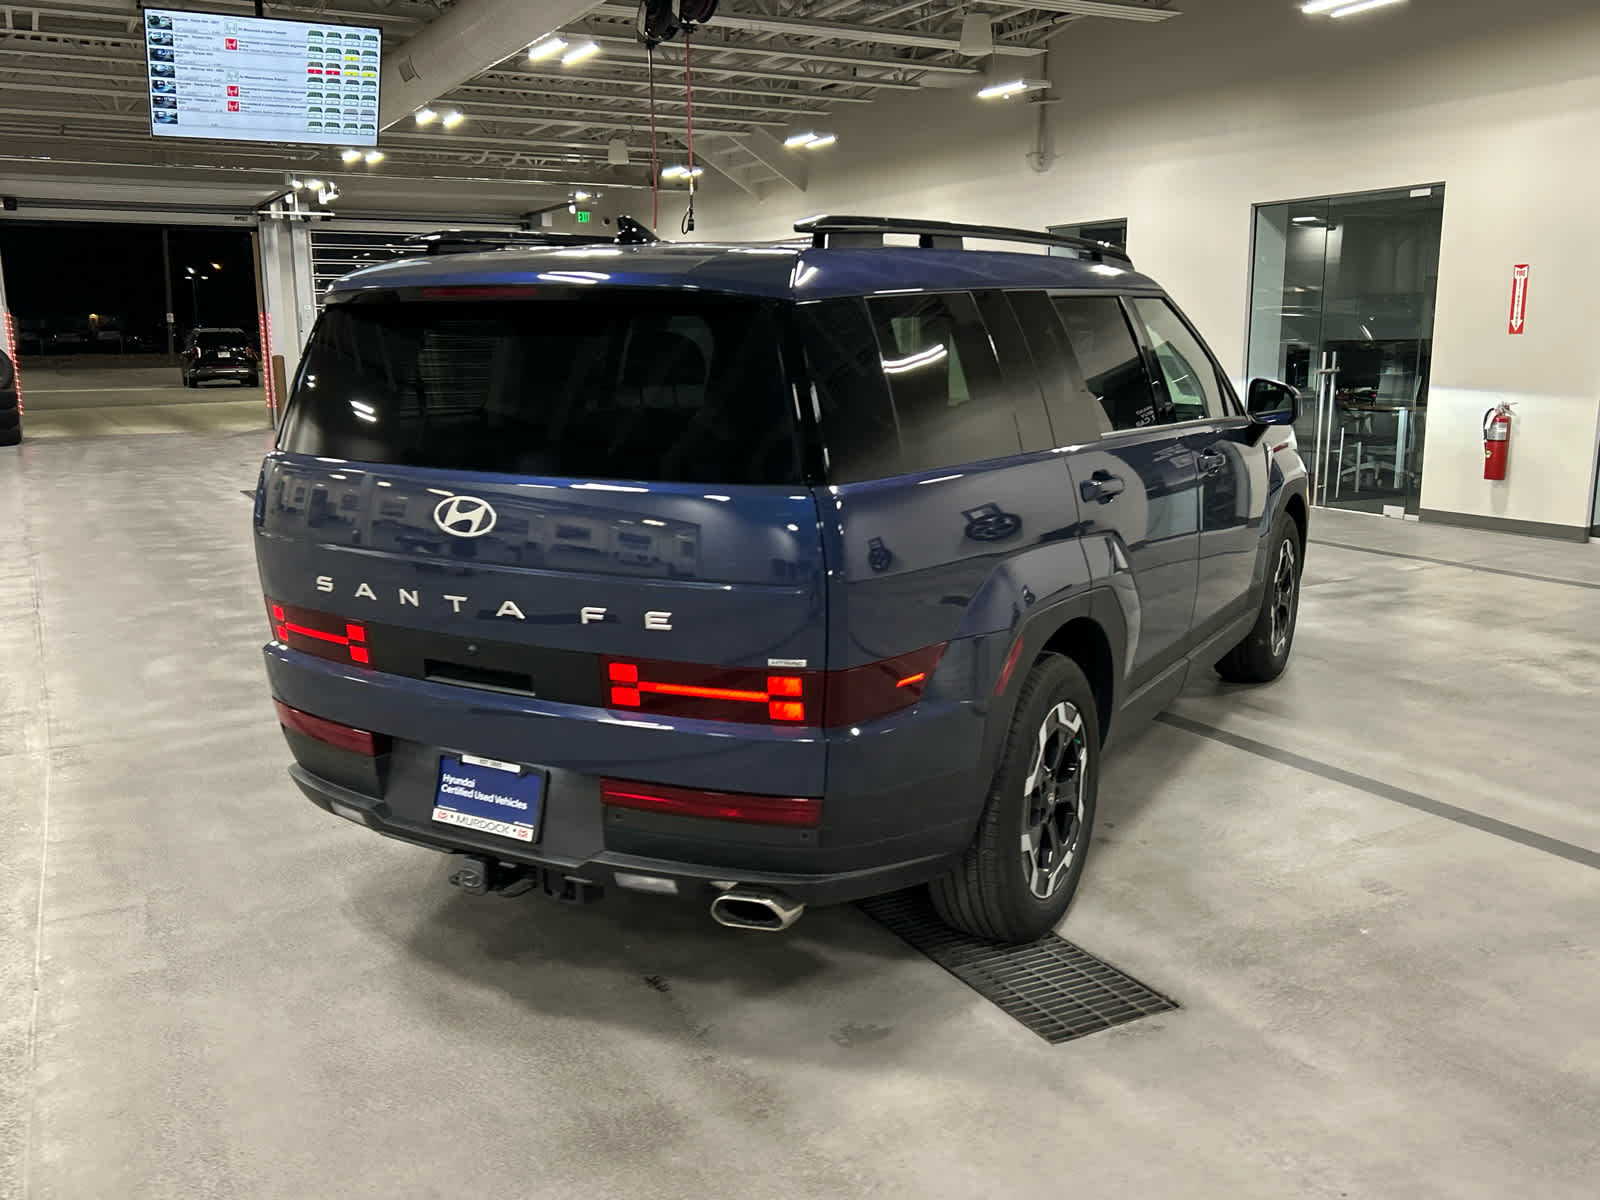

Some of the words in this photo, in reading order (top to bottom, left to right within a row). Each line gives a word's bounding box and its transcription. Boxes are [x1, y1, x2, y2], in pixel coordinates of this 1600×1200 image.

[316, 575, 526, 620] SANTA
[580, 606, 673, 631] FE
[442, 773, 476, 788] Hyundai
[441, 784, 474, 799] Certified
[474, 790, 495, 803] Used
[495, 795, 528, 810] Vehicles
